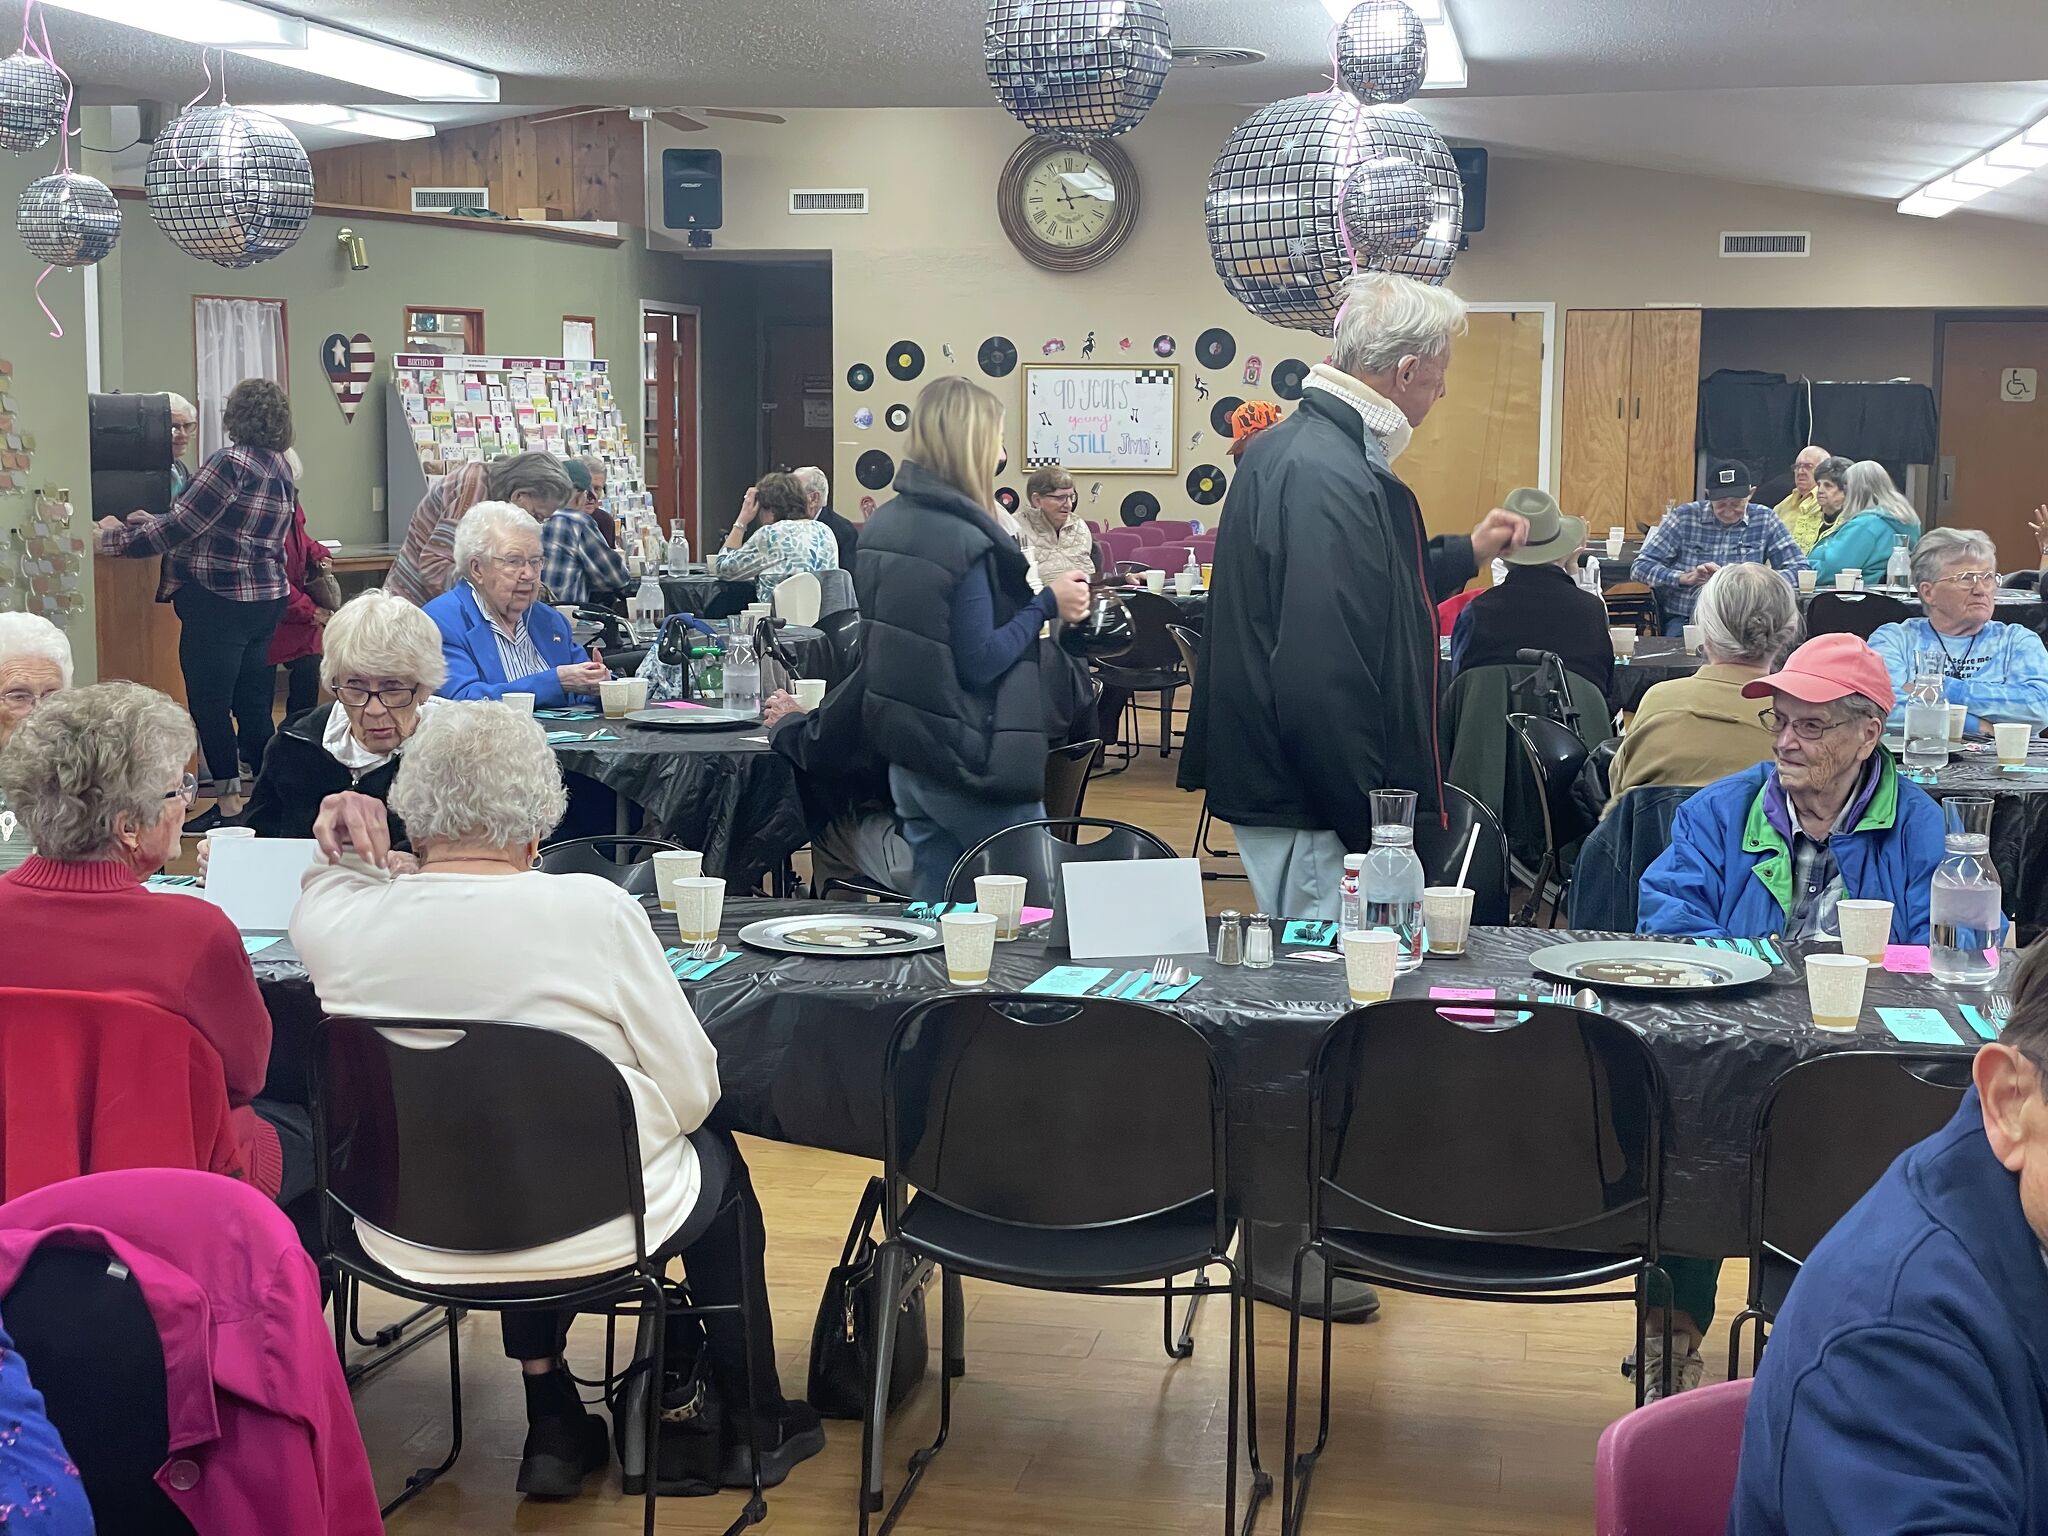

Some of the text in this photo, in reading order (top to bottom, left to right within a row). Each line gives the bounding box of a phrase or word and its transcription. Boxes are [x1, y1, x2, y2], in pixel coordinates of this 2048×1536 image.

[1054, 379, 1130, 411] 90 years
[1068, 432, 1111, 454] STILL
